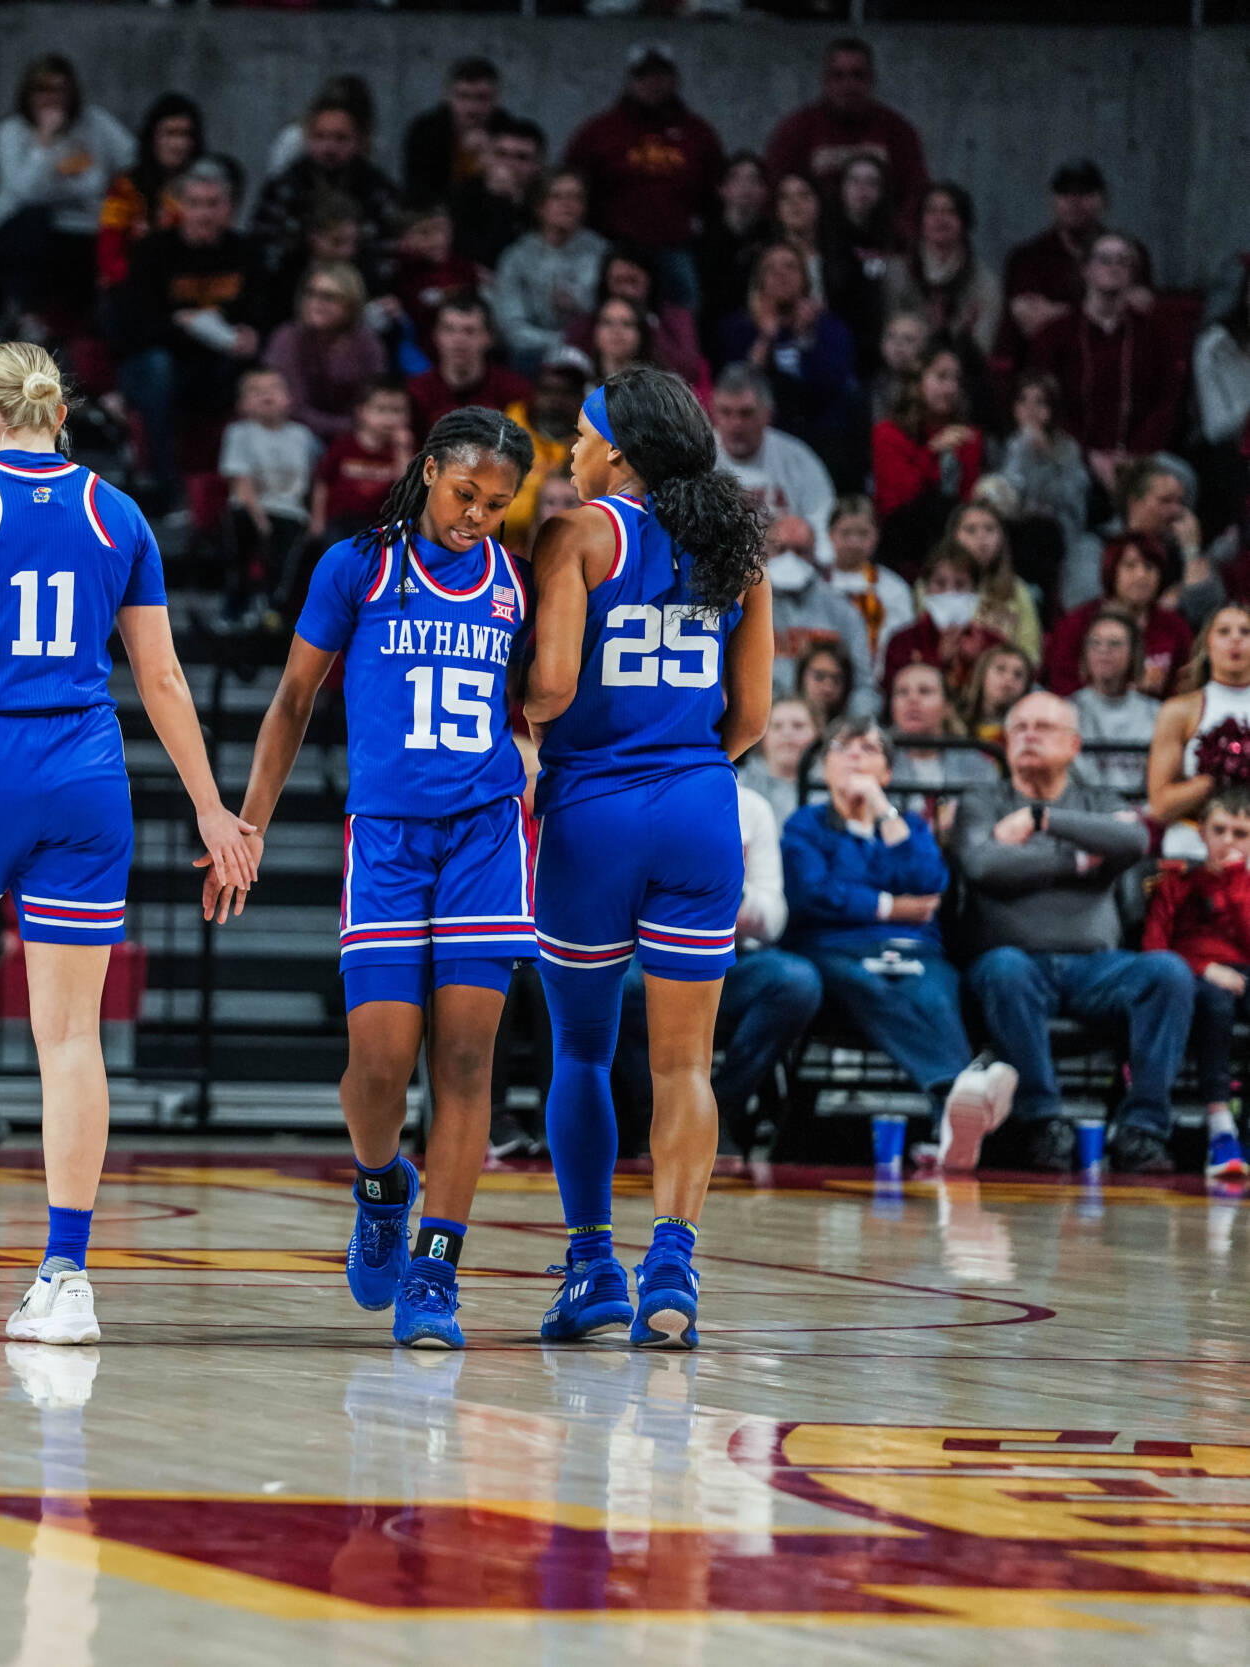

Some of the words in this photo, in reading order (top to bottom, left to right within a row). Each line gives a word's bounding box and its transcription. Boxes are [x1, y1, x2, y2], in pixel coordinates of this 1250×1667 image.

[10, 570, 77, 656] 11
[380, 620, 513, 667] JAYHAWKS
[601, 604, 720, 688] 25
[404, 666, 495, 753] 15
